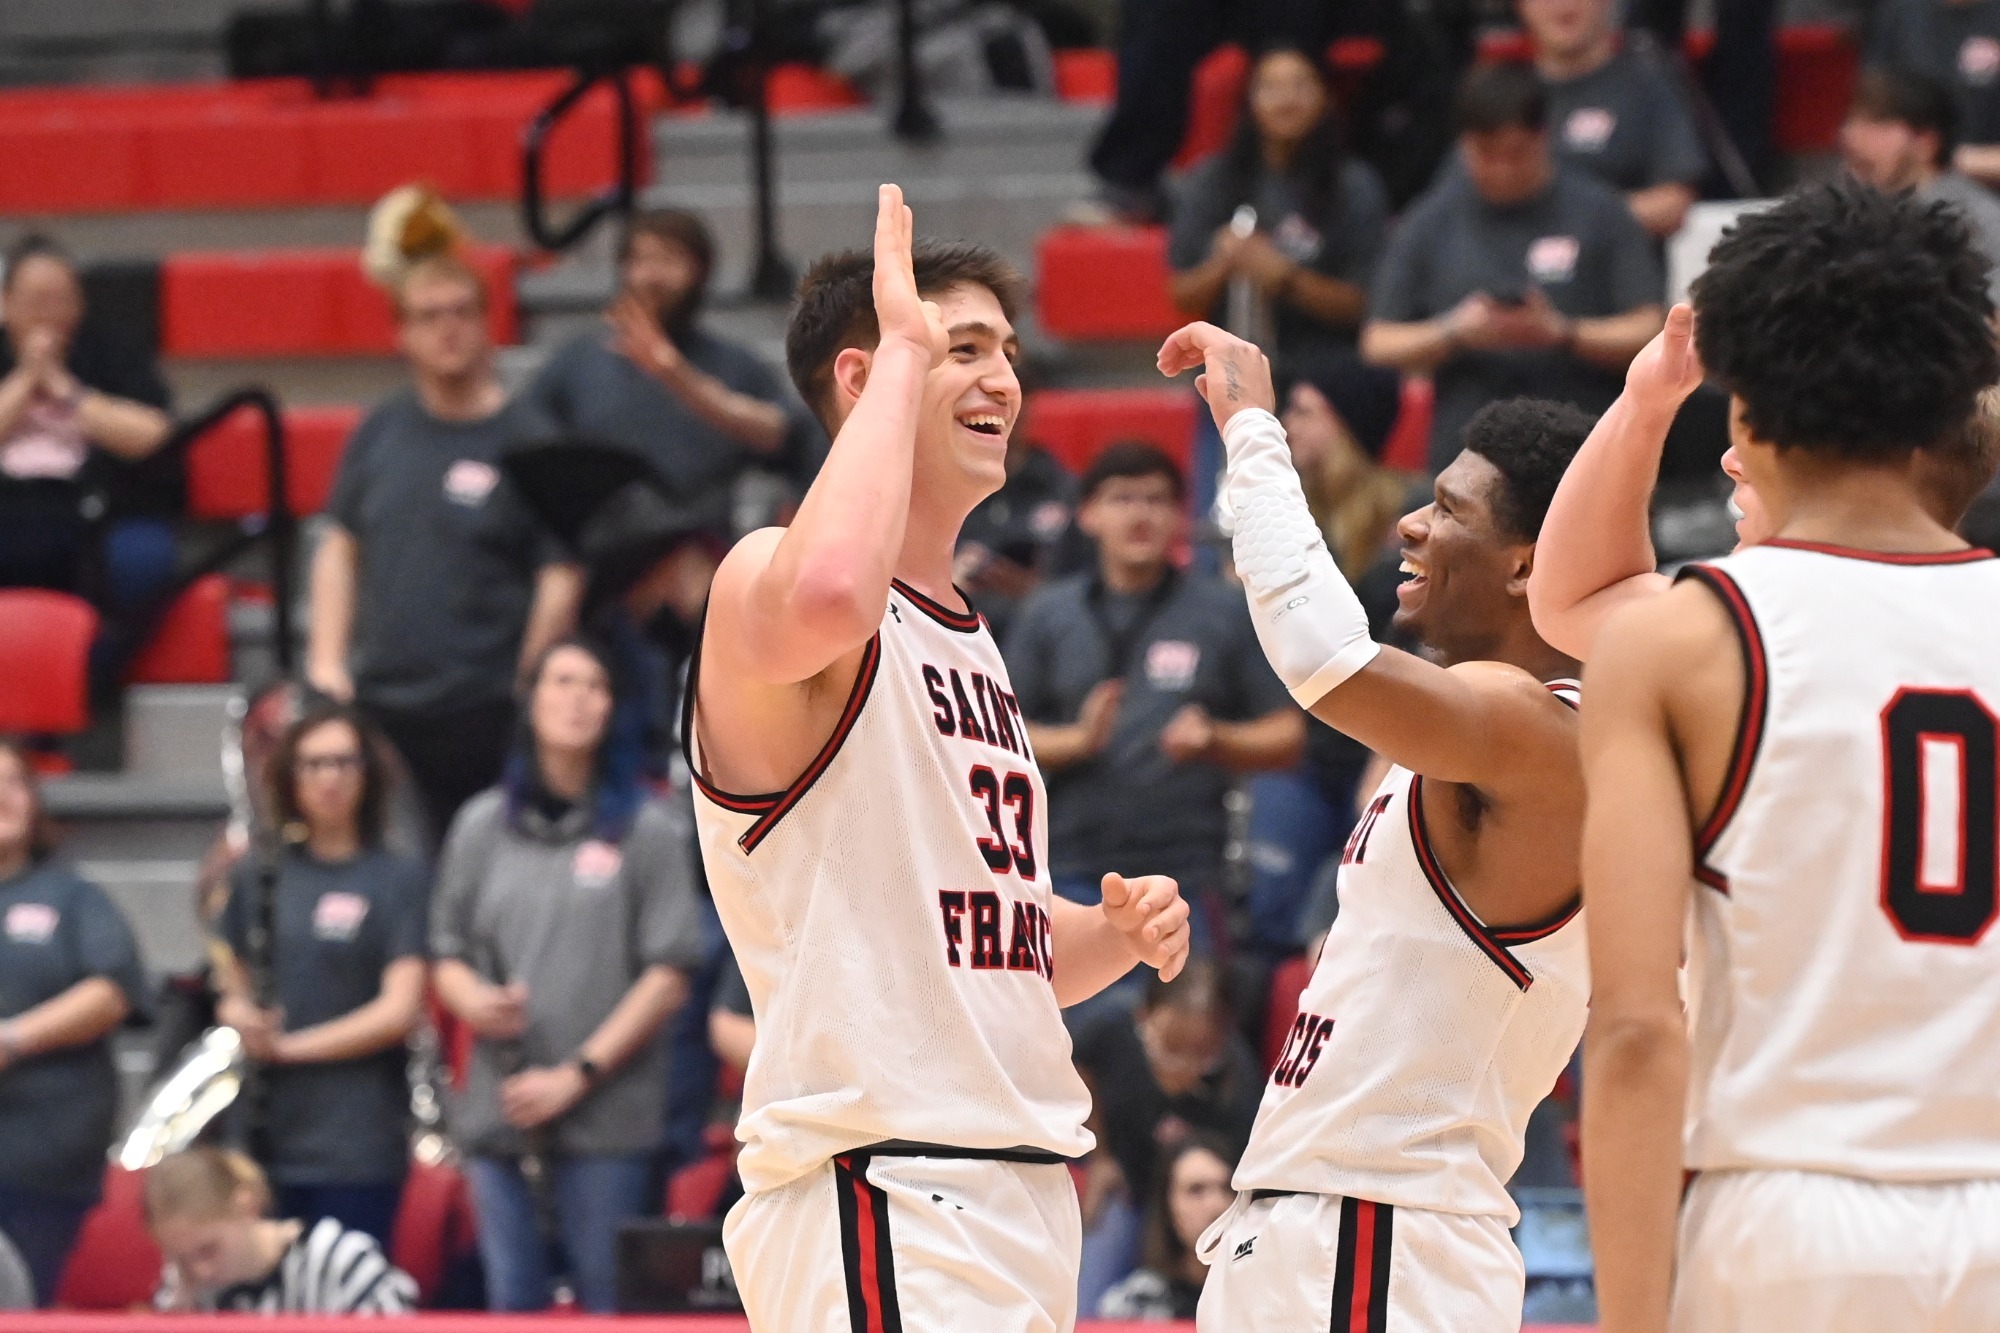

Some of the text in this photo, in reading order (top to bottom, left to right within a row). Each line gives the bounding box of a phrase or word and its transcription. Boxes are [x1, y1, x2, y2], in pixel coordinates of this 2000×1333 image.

[921, 663, 1031, 762] SAINT
[969, 764, 1038, 881] 33
[1879, 686, 2000, 947] 0
[1271, 1012, 1336, 1089] CIS
